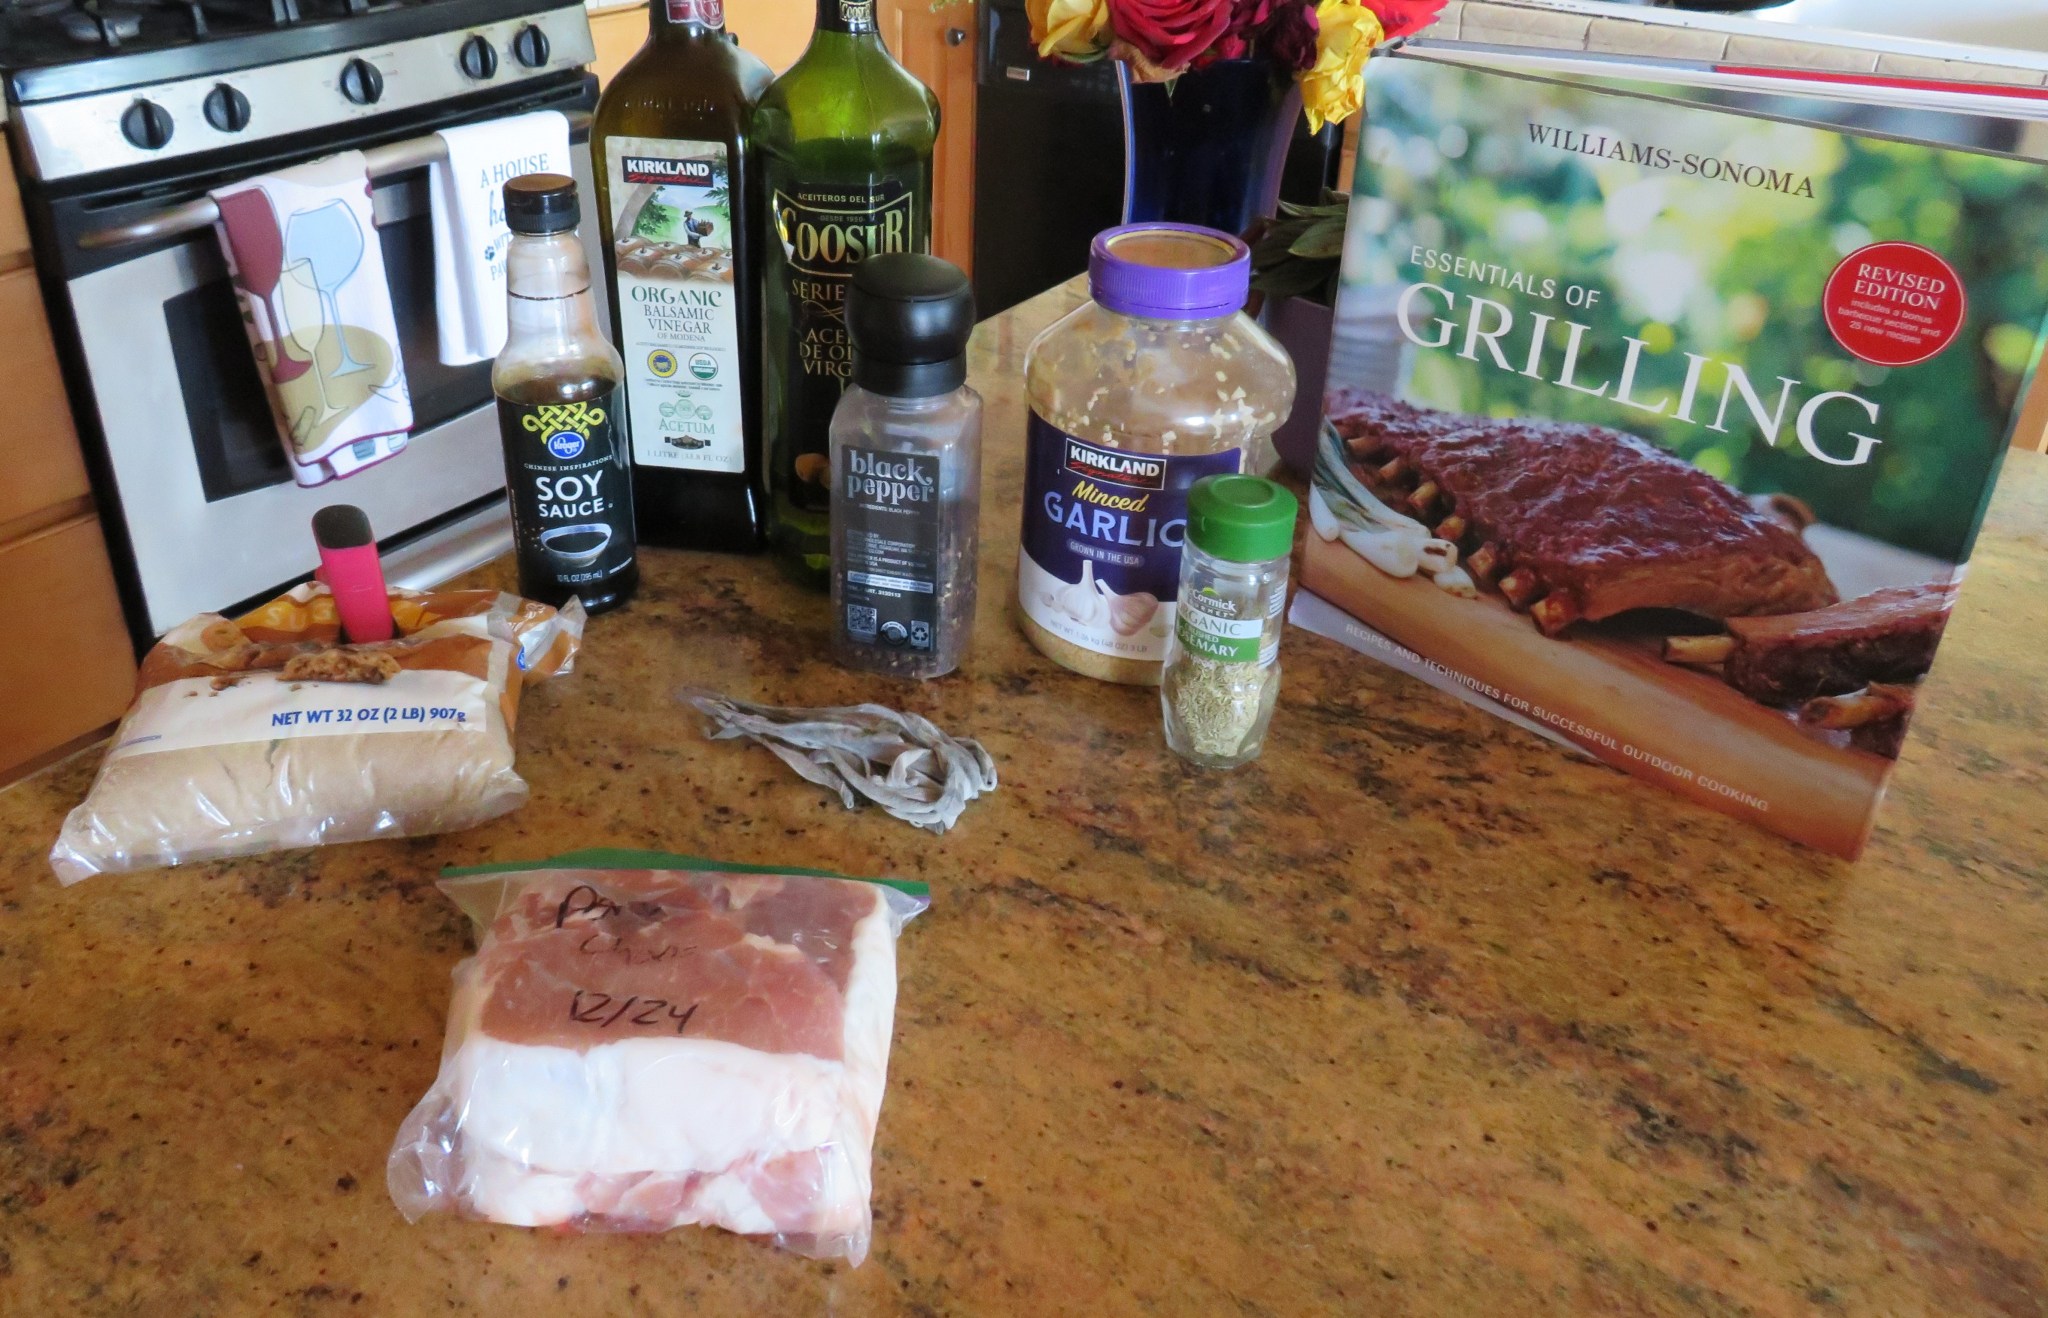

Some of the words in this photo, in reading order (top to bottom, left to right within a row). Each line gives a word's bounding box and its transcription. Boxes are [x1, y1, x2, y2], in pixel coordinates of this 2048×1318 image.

[480, 168, 489, 189] A
[493, 152, 550, 184] HOUSE
[626, 159, 710, 178] KIRKLAND
[1527, 122, 1816, 200] WILLIAMS-SONOMA
[797, 192, 847, 203] ACEITEROS
[849, 194, 867, 204] DEL
[779, 206, 904, 264] COOSUR
[1410, 244, 1557, 301] ESSENTIALS
[1565, 283, 1601, 311] OF
[1857, 263, 1946, 294] REVISED
[631, 285, 723, 308] ORGANIC
[1853, 279, 1941, 311] EDITION
[643, 304, 715, 321] BALSAMIC
[648, 318, 713, 335] VINEGAR
[657, 331, 672, 340] OF
[673, 333, 706, 342] MODENA
[1920, 325, 1942, 338] and
[1396, 281, 1884, 468] GRILLING
[658, 417, 716, 435] ACETUM
[849, 449, 934, 486] black
[1070, 445, 1160, 477] KIRKLAND
[535, 469, 604, 501] SOY
[847, 474, 935, 506] pepper
[1072, 480, 1150, 513] Minced
[538, 498, 605, 519] SAUCE
[1044, 491, 1187, 547] GARLIC
[1070, 540, 1094, 557] GROWN
[1096, 548, 1105, 559] IN
[1107, 551, 1121, 563] THE
[1123, 554, 1140, 566] USA
[272, 711, 302, 727] NET
[306, 709, 334, 724] WT
[336, 708, 353, 722] 32
[357, 707, 380, 721] OZ
[383, 706, 398, 724] (2
[401, 706, 426, 723] LB)
[429, 707, 467, 723] 907g
[1345, 623, 1393, 651] RECIPES
[1394, 645, 1422, 664] AND
[1423, 656, 1501, 700] TECHNIQUES
[1502, 692, 1530, 713] FOR
[1532, 704, 1618, 751] SUCCESSFUL
[1621, 743, 1694, 782] OUTDOOR
[1696, 774, 1769, 813] COOKING
[568, 989, 699, 1035] 12/24
